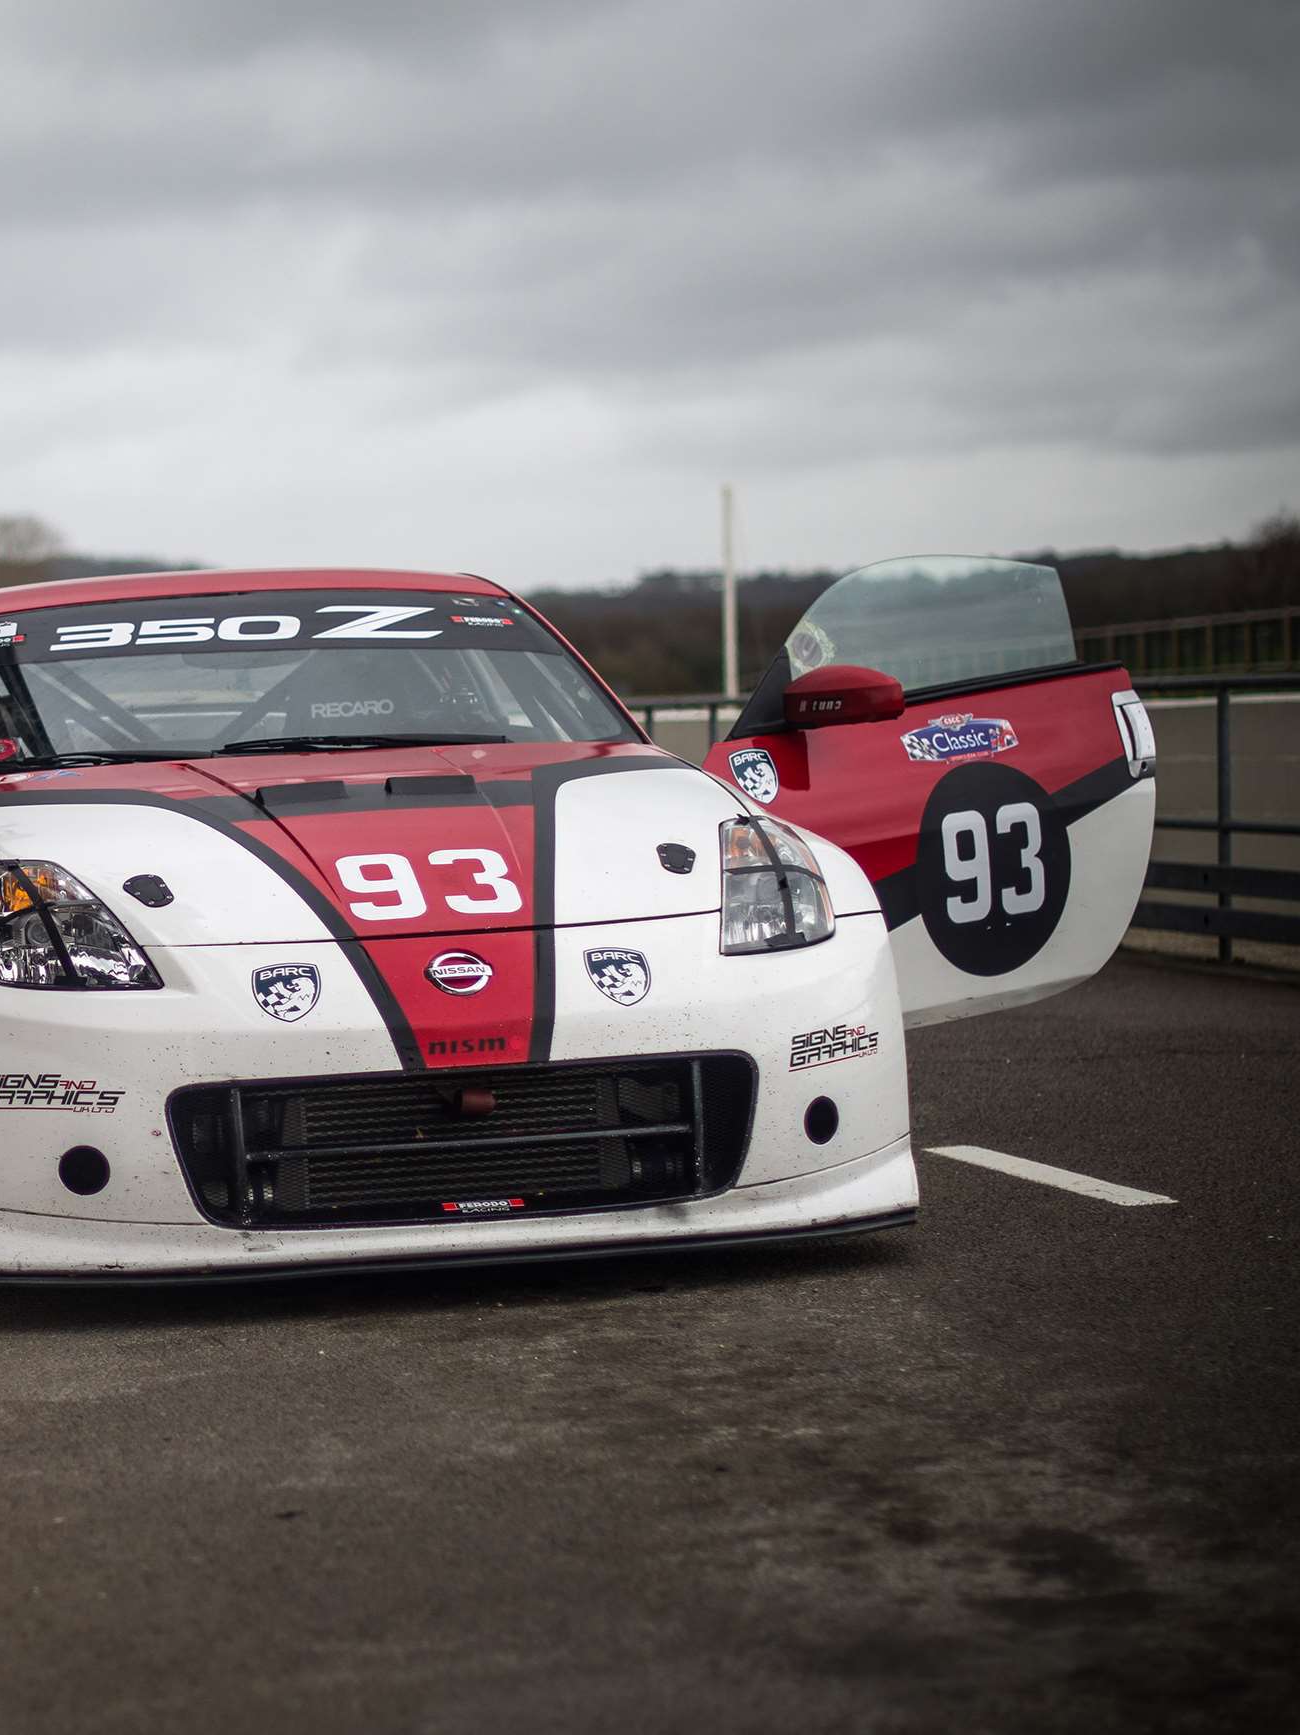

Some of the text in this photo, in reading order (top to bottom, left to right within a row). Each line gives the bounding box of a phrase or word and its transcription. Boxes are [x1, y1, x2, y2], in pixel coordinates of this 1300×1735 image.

[311, 699, 395, 719] RECARO
[932, 729, 988, 752] Classic
[733, 752, 768, 767] BARC
[941, 802, 1046, 924] 93
[335, 849, 523, 921] 93
[591, 951, 641, 963] BARC
[260, 967, 312, 981] BARC
[432, 966, 487, 977] NISSAN
[790, 1031, 879, 1067] GRAPHICS
[459, 1200, 508, 1209] FERODO
